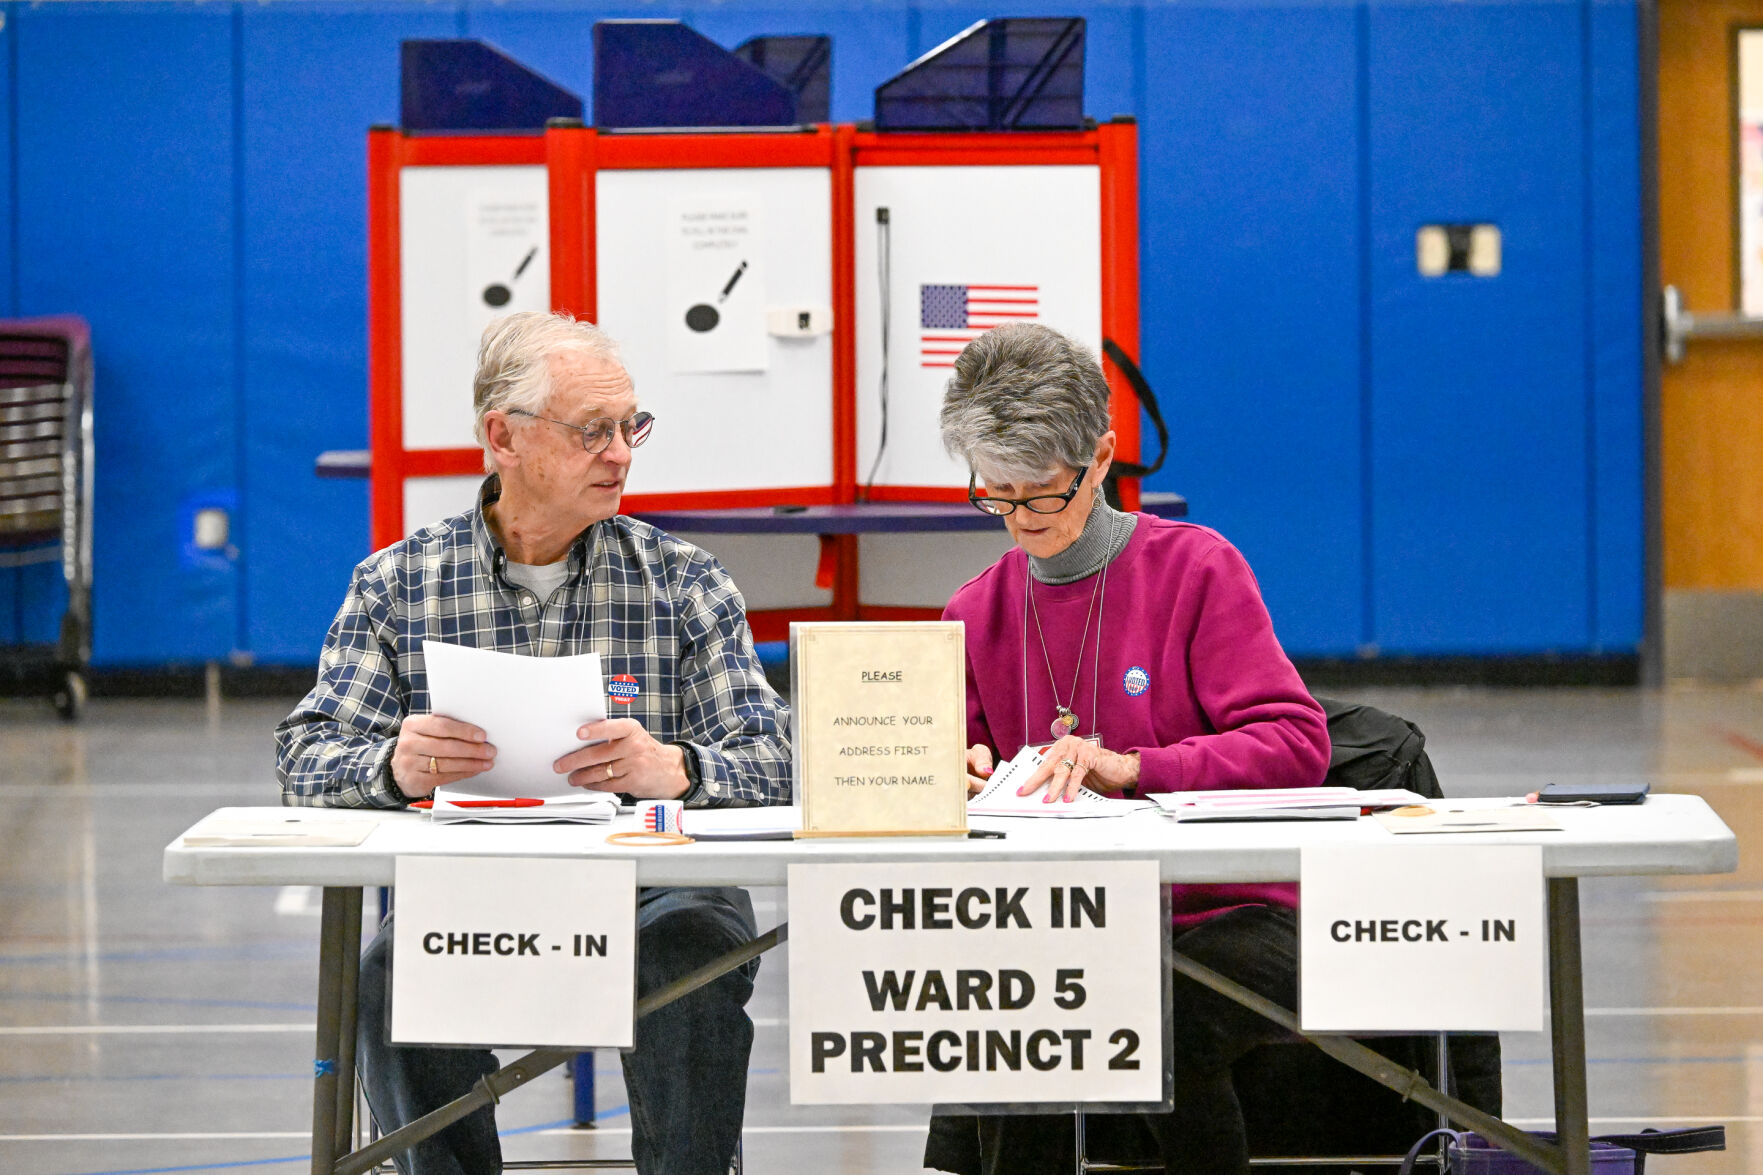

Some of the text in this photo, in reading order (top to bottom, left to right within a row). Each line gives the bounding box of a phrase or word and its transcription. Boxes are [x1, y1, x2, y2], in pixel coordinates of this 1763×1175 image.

[861, 671, 903, 682] PLEASE
[610, 685, 637, 693] VOTED
[833, 715, 934, 726] ANNOUNCE YOUR
[839, 745, 929, 756] ADDRESS FIRST
[834, 776, 866, 786] THEN
[868, 776, 899, 786] YOUR
[841, 886, 1106, 930] CHECK IN
[1330, 919, 1449, 943] CHECK
[1482, 919, 1515, 942] IN
[422, 932, 540, 956] CHECK
[573, 934, 607, 957] IN
[862, 968, 1087, 1012] WARD 5
[811, 1028, 1141, 1073] PRECINCT 2
